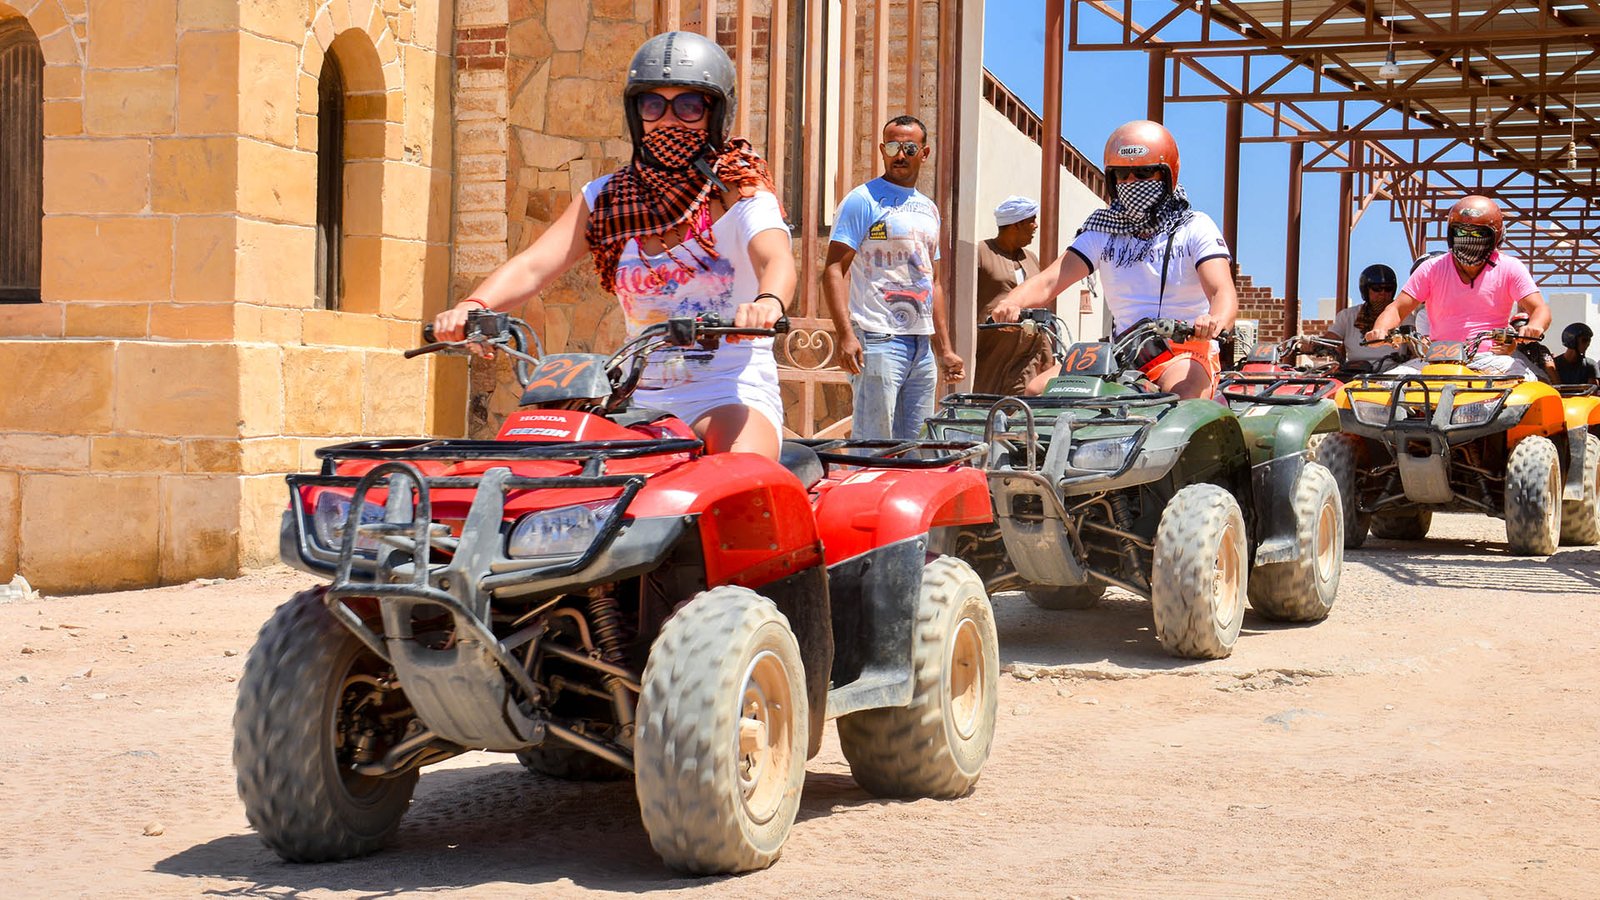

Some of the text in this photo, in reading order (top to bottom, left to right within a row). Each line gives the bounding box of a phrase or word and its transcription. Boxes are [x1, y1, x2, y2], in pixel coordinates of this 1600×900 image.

[1065, 345, 1103, 373] 15
[1428, 343, 1460, 359] 26
[526, 359, 594, 392] 21
[520, 415, 568, 423] HONDA
[504, 427, 571, 438] RECON
